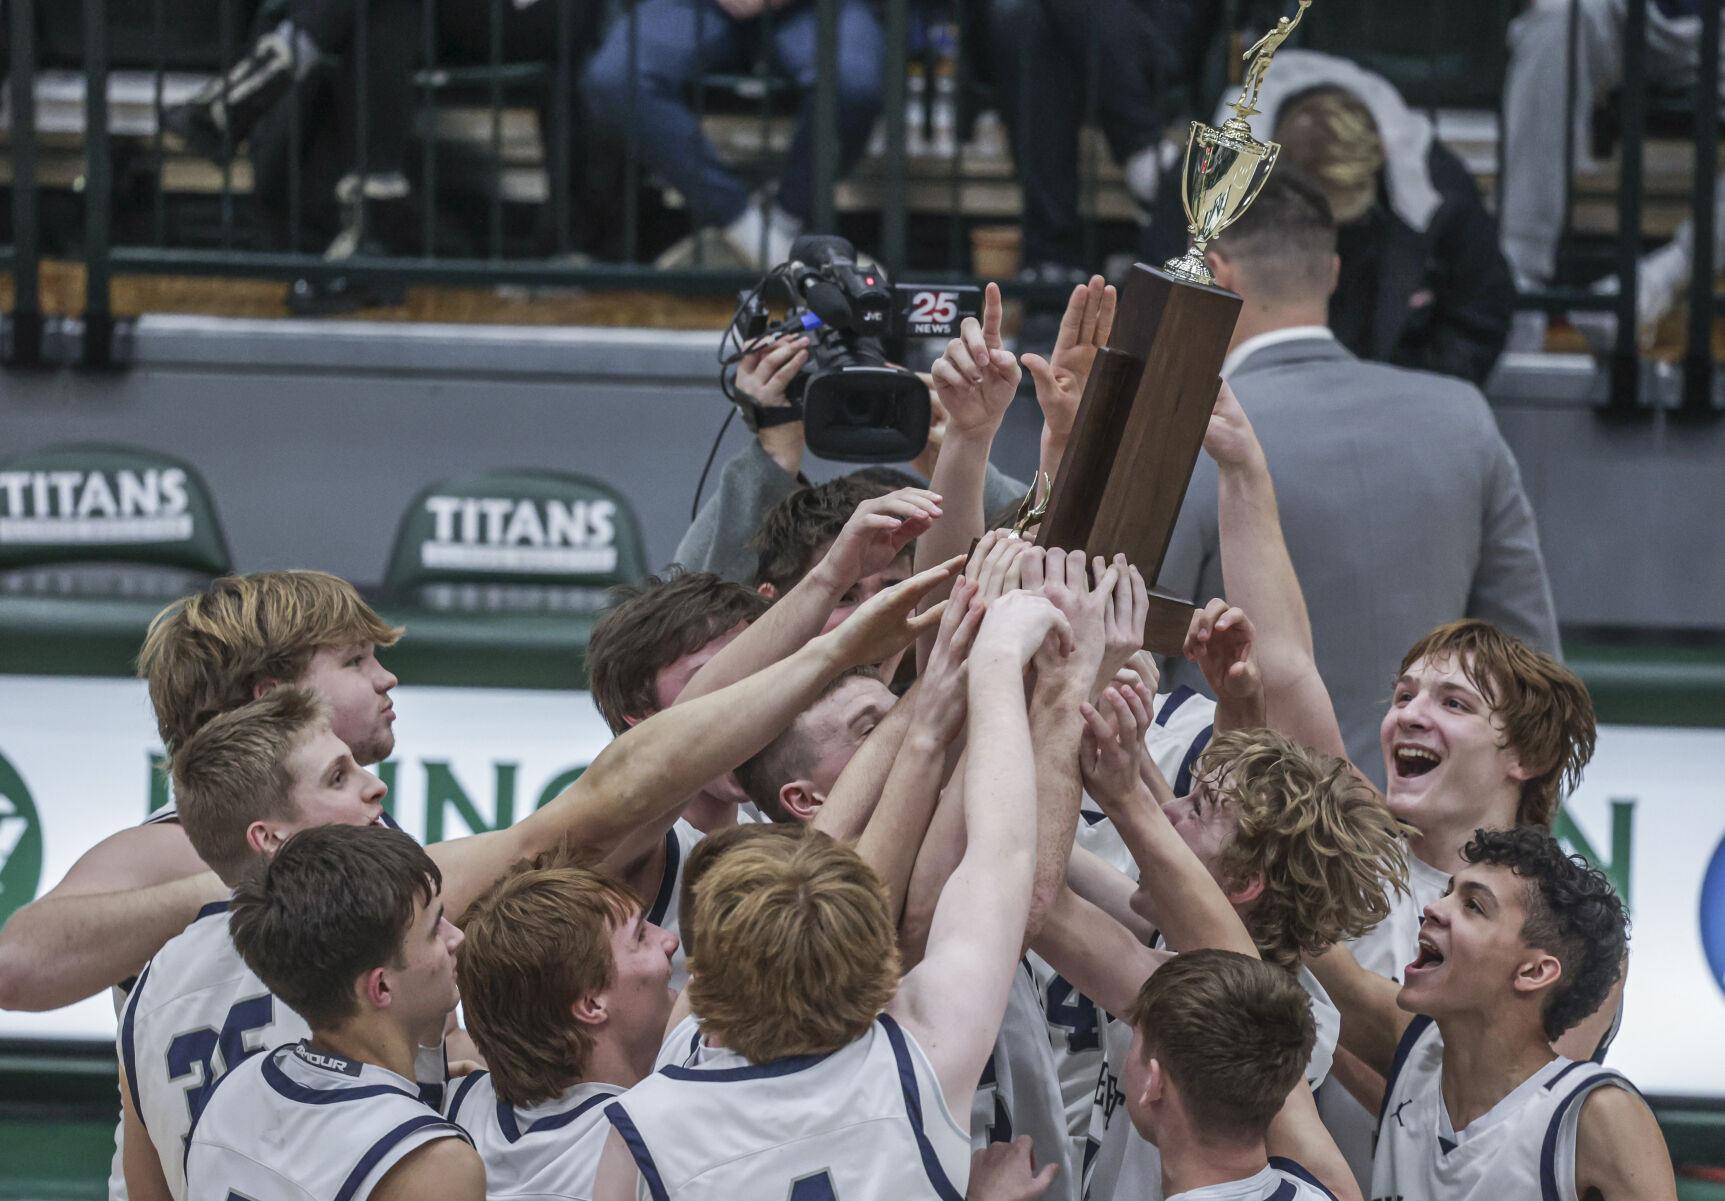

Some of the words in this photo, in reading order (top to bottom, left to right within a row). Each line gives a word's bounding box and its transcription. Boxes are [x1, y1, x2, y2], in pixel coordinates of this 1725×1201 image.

[863, 311, 883, 321] JVC
[907, 291, 959, 323] 25
[914, 323, 952, 334] NEWS
[0, 467, 188, 516] TITANS
[426, 496, 616, 546] TITANS
